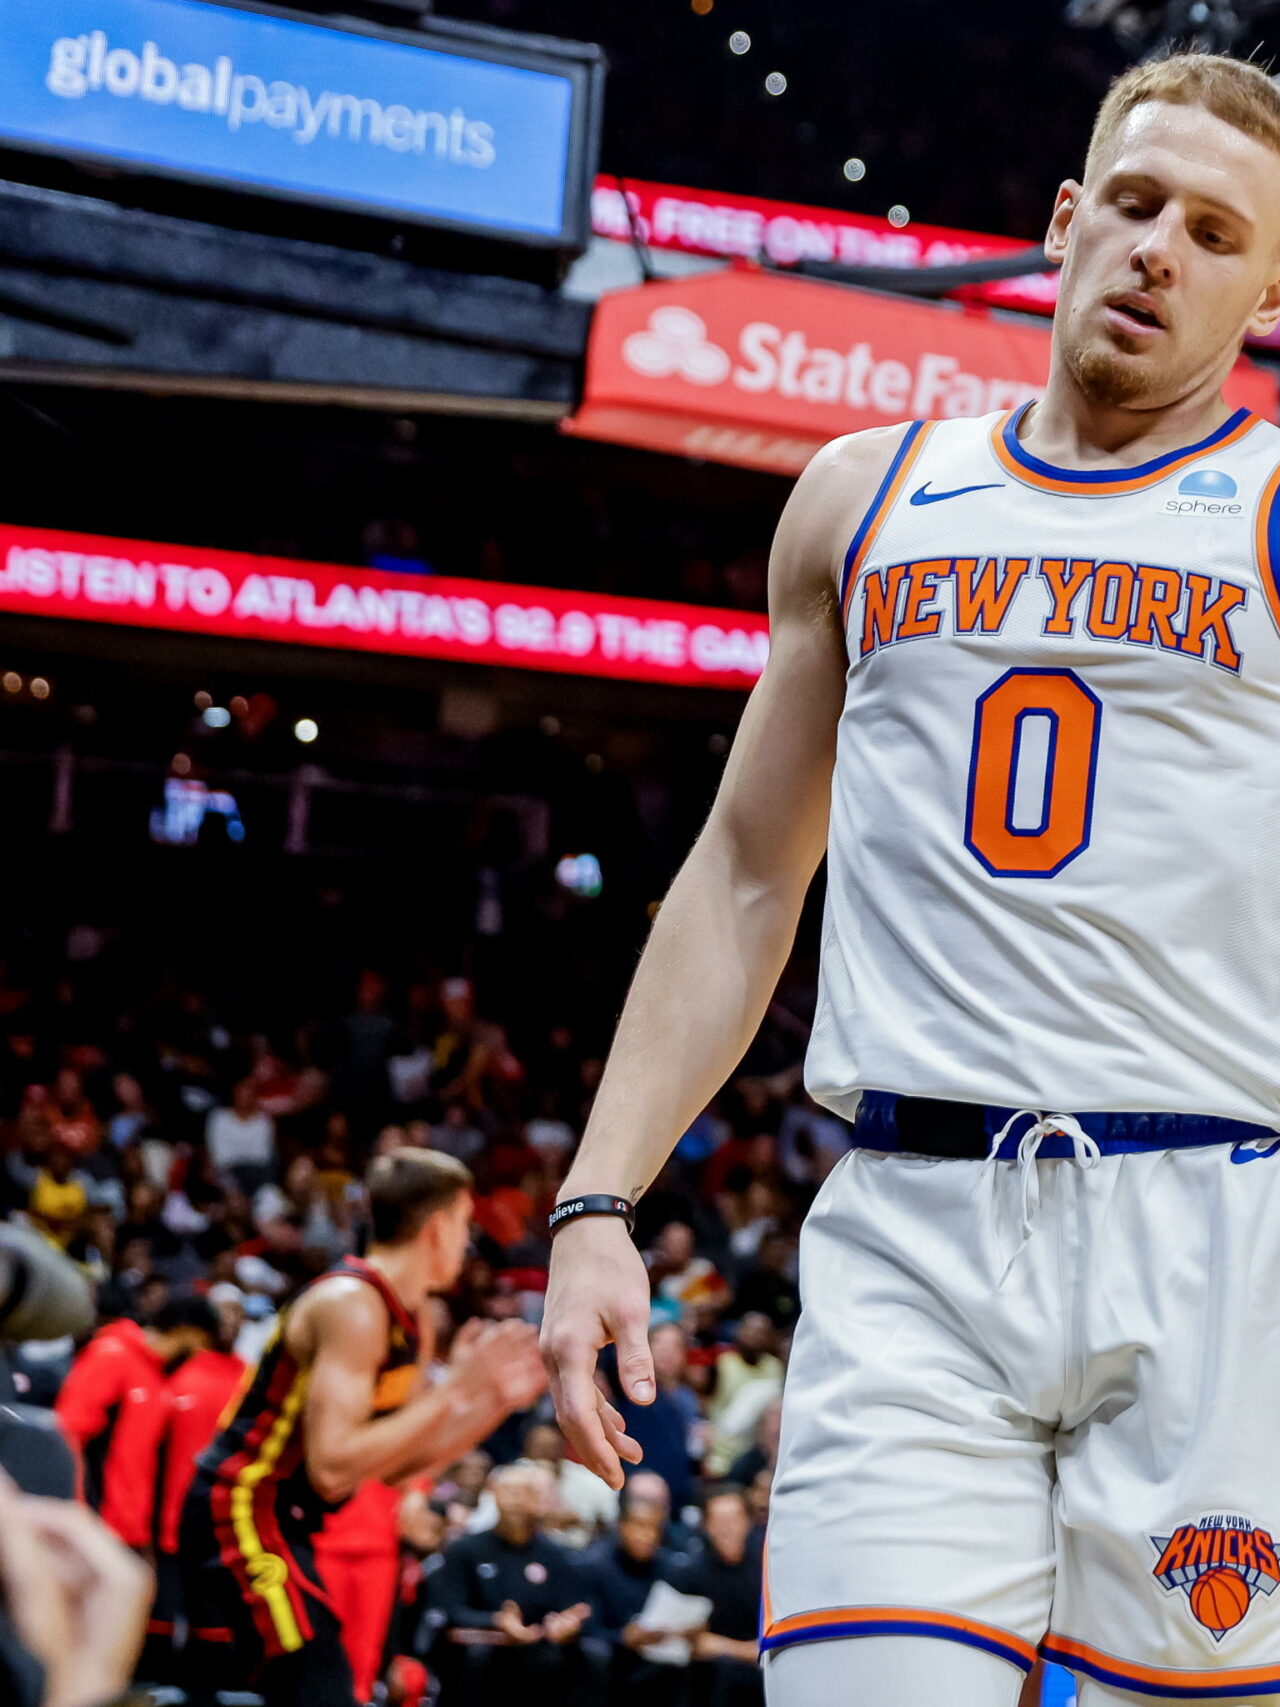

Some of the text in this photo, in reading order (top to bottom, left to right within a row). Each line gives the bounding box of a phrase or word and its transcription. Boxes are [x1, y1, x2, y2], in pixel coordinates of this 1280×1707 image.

[1166, 500, 1242, 515] sphere
[157, 563, 232, 616] TO
[494, 603, 596, 658] 92.9
[596, 612, 689, 669] THE
[859, 555, 1250, 676] NEW YORK
[963, 667, 1103, 879] 0
[1199, 1514, 1252, 1530] NEW YORK
